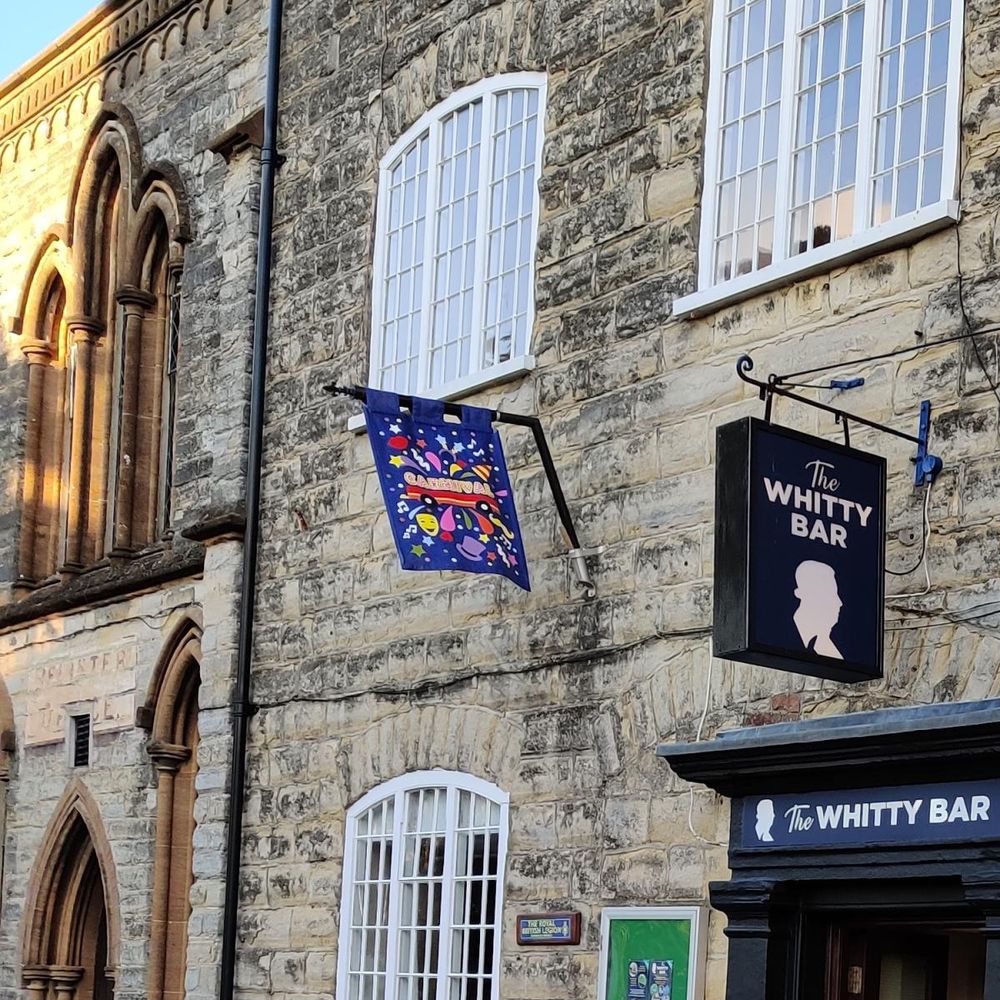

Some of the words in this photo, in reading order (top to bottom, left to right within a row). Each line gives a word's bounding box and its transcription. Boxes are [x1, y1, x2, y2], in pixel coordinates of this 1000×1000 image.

[403, 471, 496, 498] CARNIVAL
[805, 459, 841, 492] The
[763, 476, 873, 527] WHITTY
[790, 512, 848, 549] BAR
[784, 803, 815, 834] The
[815, 799, 923, 830] WHITTY
[928, 795, 991, 824] BAR
